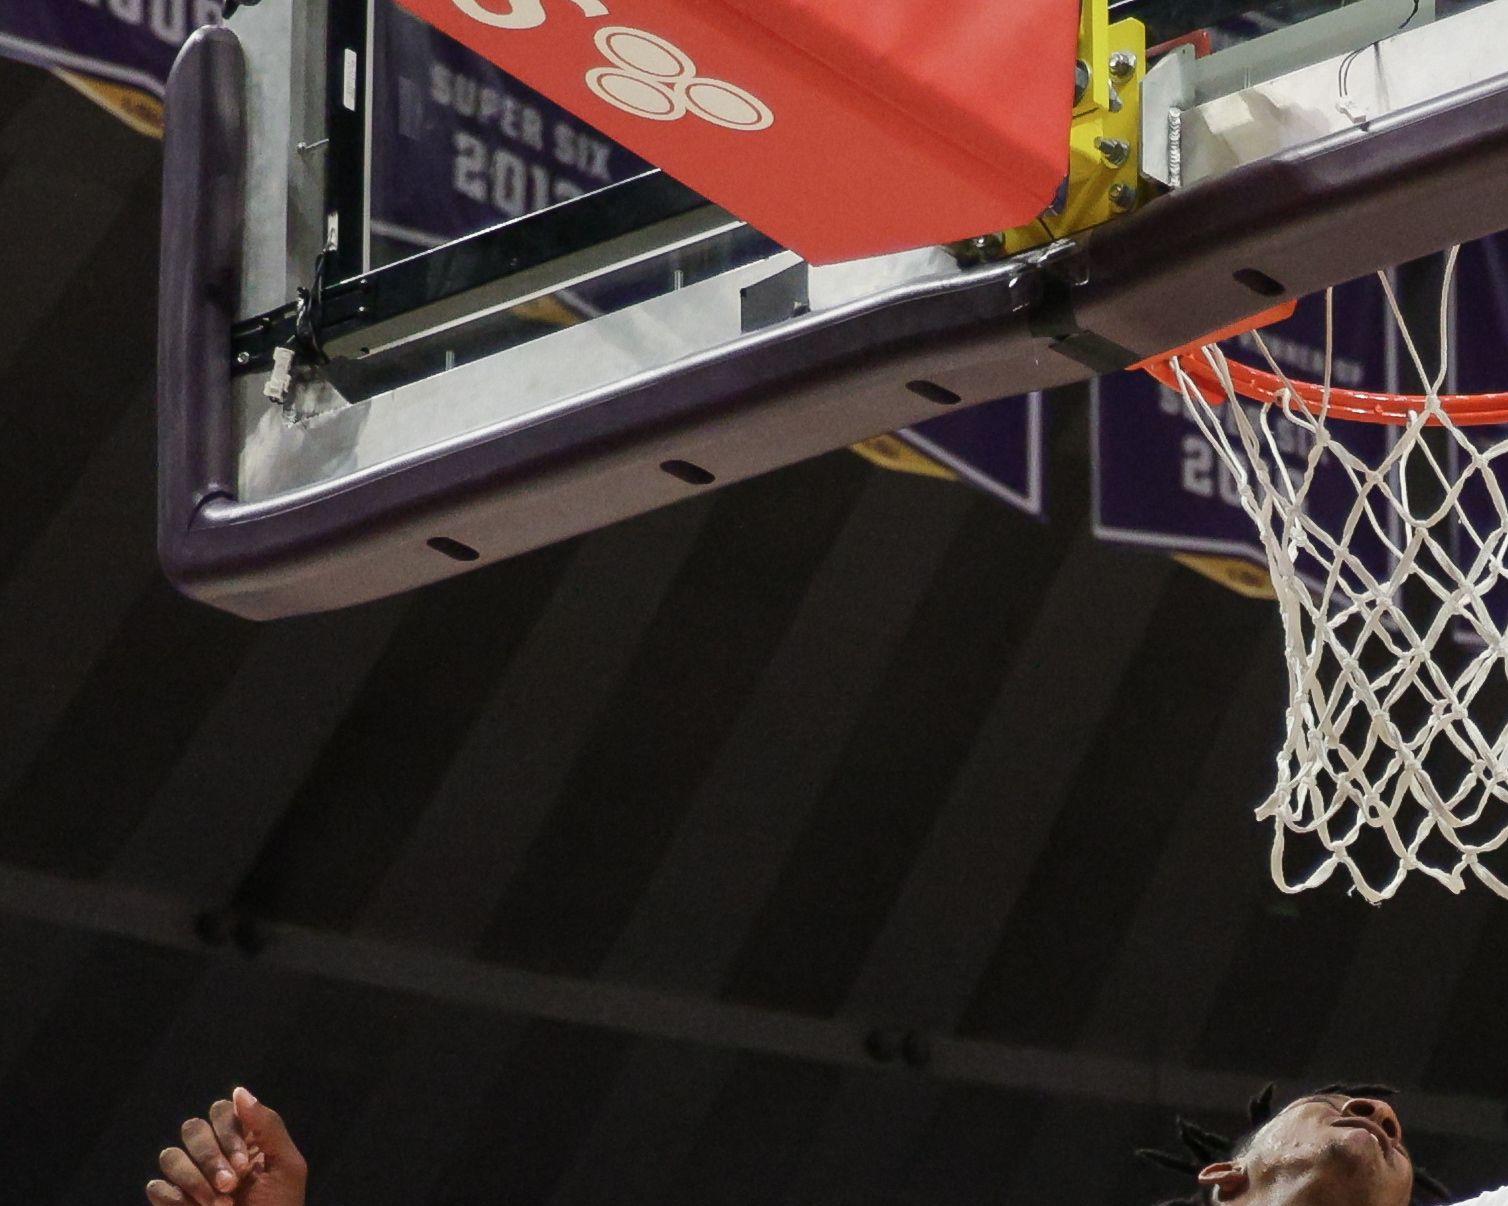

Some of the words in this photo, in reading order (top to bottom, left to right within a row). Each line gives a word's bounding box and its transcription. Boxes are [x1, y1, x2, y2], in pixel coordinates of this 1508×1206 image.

[431, 62, 545, 150] SUPER
[553, 122, 614, 184] SIX
[453, 130, 584, 217] 201
